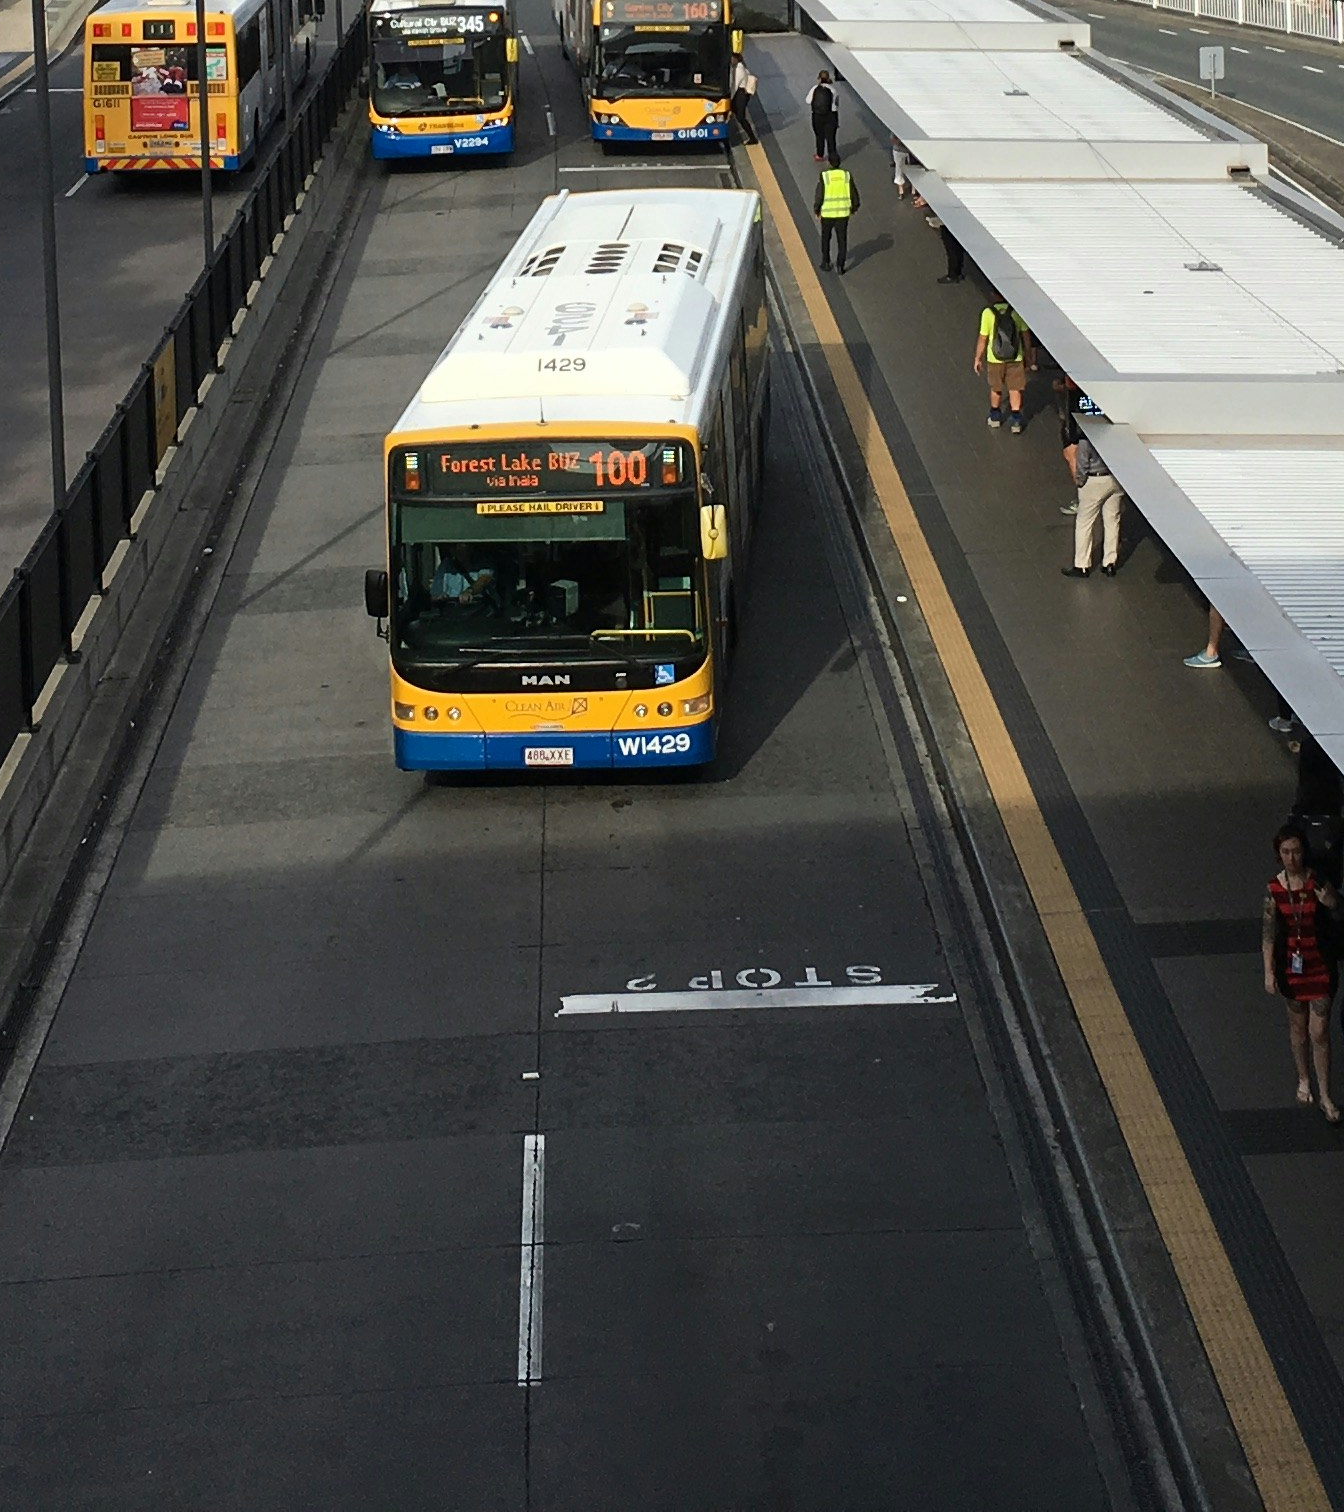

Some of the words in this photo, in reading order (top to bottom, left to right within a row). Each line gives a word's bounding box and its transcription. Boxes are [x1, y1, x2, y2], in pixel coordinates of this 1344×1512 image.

[683, 2, 709, 20] 160
[390, 18, 423, 29] Cultural
[457, 15, 485, 33] 345
[538, 357, 587, 372] 1429
[440, 453, 496, 473] Forest
[501, 453, 542, 472] Lake
[548, 451, 581, 471] BUZ
[588, 449, 647, 487] 100
[486, 475, 506, 487] via
[487, 503, 525, 512] PLEASE
[529, 502, 552, 512] HAIL
[555, 502, 593, 511] DRIVER
[521, 674, 571, 686] MAN
[617, 733, 691, 756] W1429
[549, 749, 571, 761] XXE
[688, 965, 882, 990] STOP
